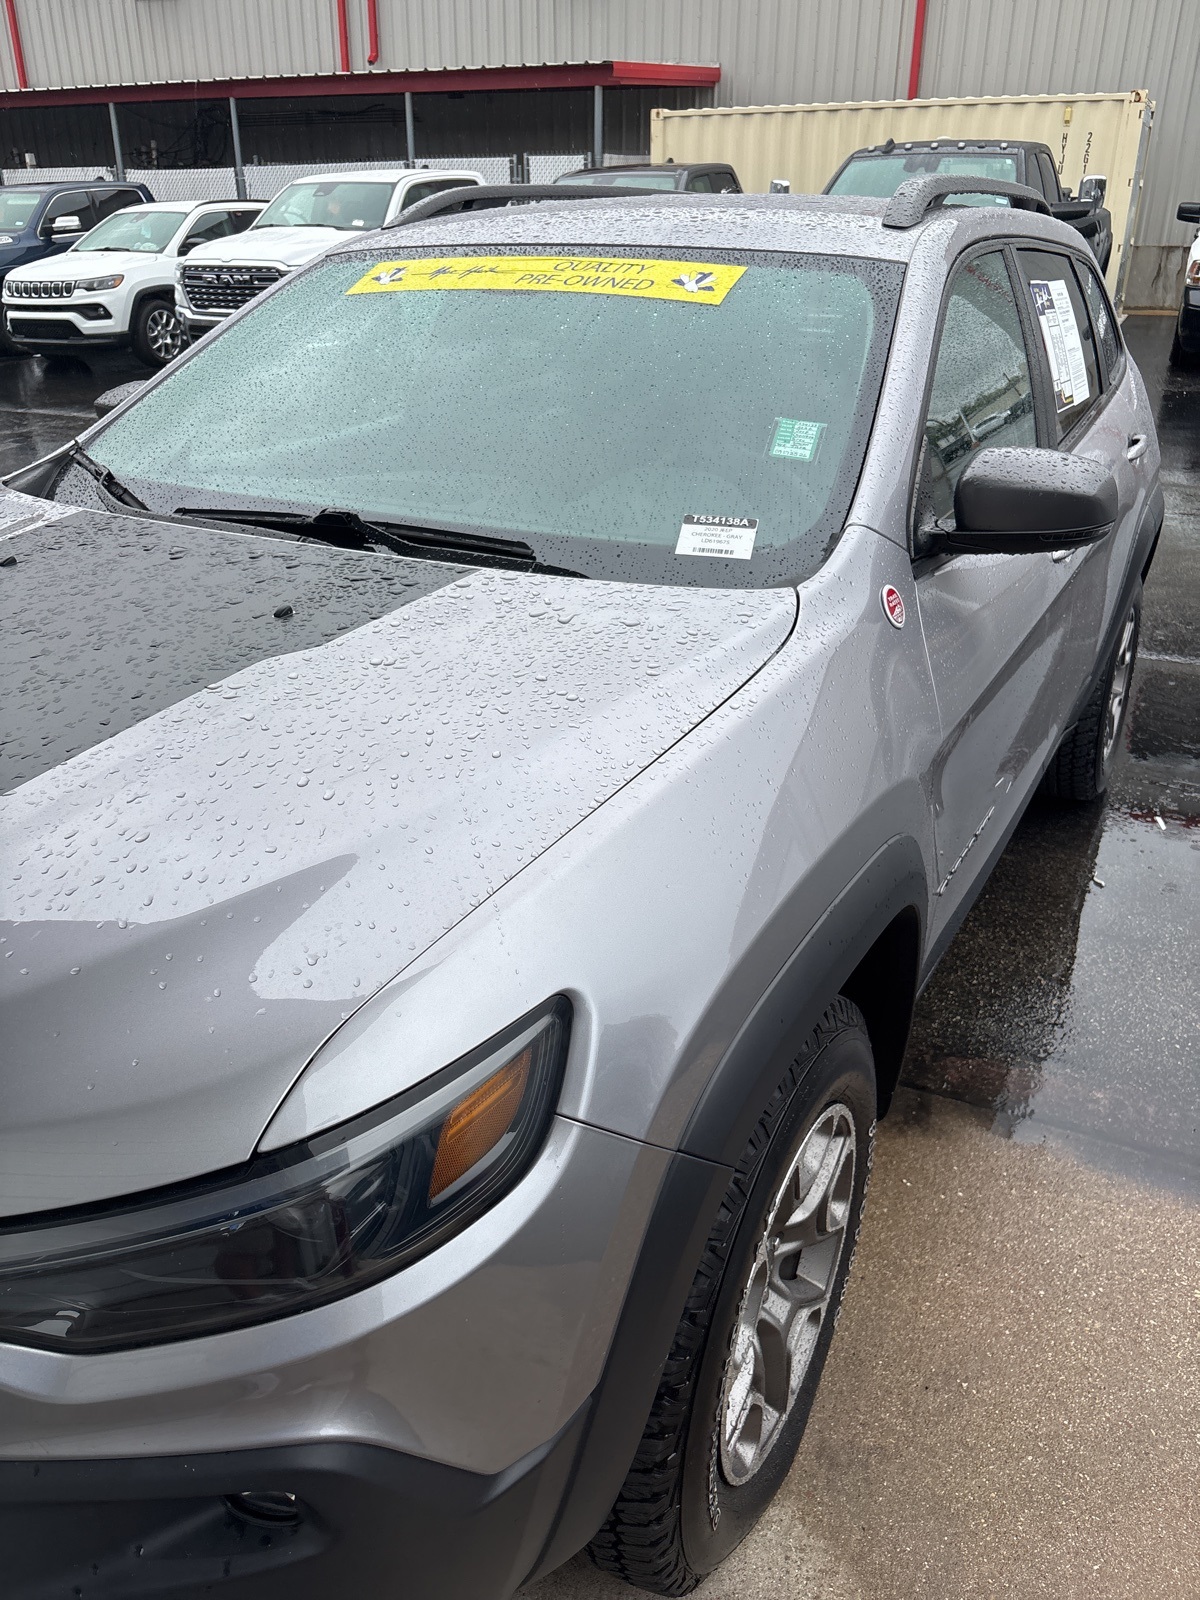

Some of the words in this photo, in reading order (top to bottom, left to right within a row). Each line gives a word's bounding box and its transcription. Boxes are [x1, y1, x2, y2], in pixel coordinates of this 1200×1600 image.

[1057, 133, 1068, 175] HYJU
[1083, 132, 1093, 174] 22G1
[553, 261, 656, 275] QUALITY
[202, 274, 250, 284] RAM
[514, 273, 655, 291] PRE-OWNED
[692, 514, 749, 527] T534138A
[691, 531, 722, 539] CHEROKEE
